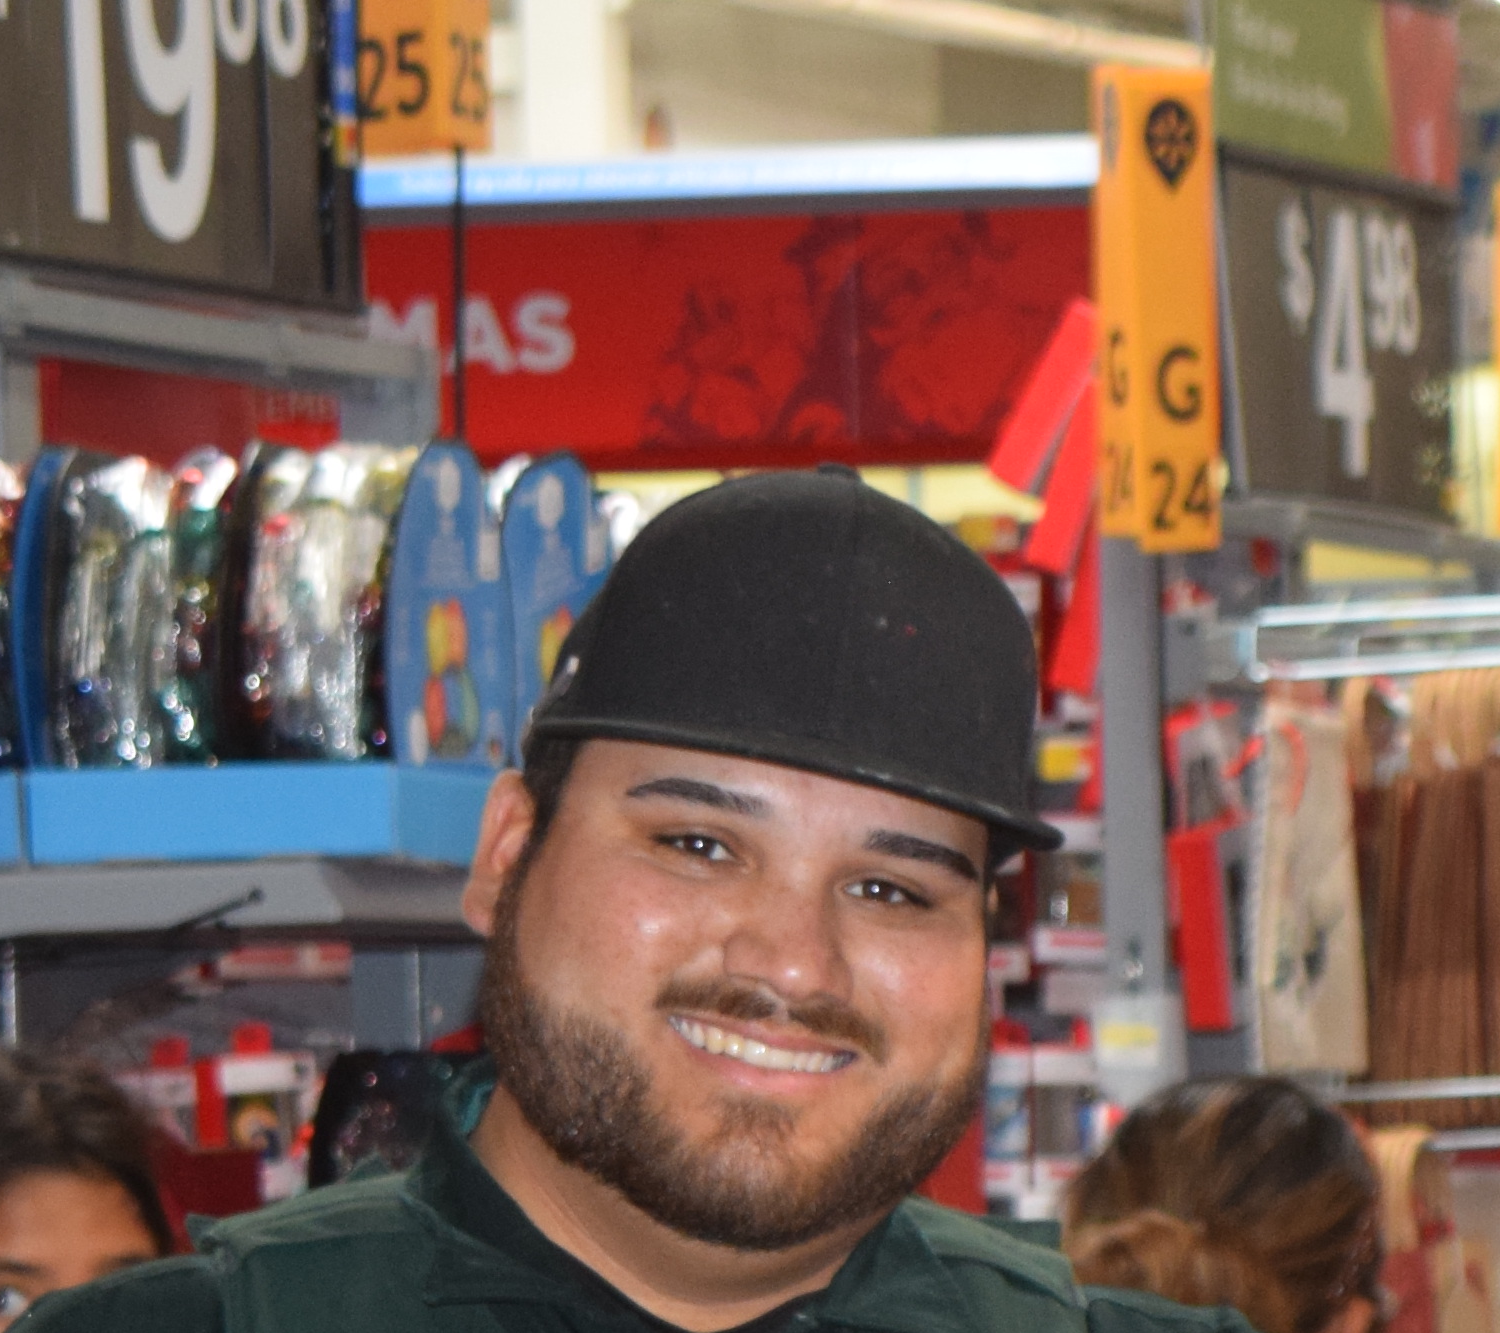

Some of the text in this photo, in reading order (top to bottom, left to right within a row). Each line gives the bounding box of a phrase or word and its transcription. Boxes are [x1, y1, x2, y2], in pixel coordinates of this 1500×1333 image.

[357, 30, 430, 119] 25
[450, 34, 489, 121] 25
[1155, 345, 1204, 424] G
[1151, 458, 1213, 532] 24
